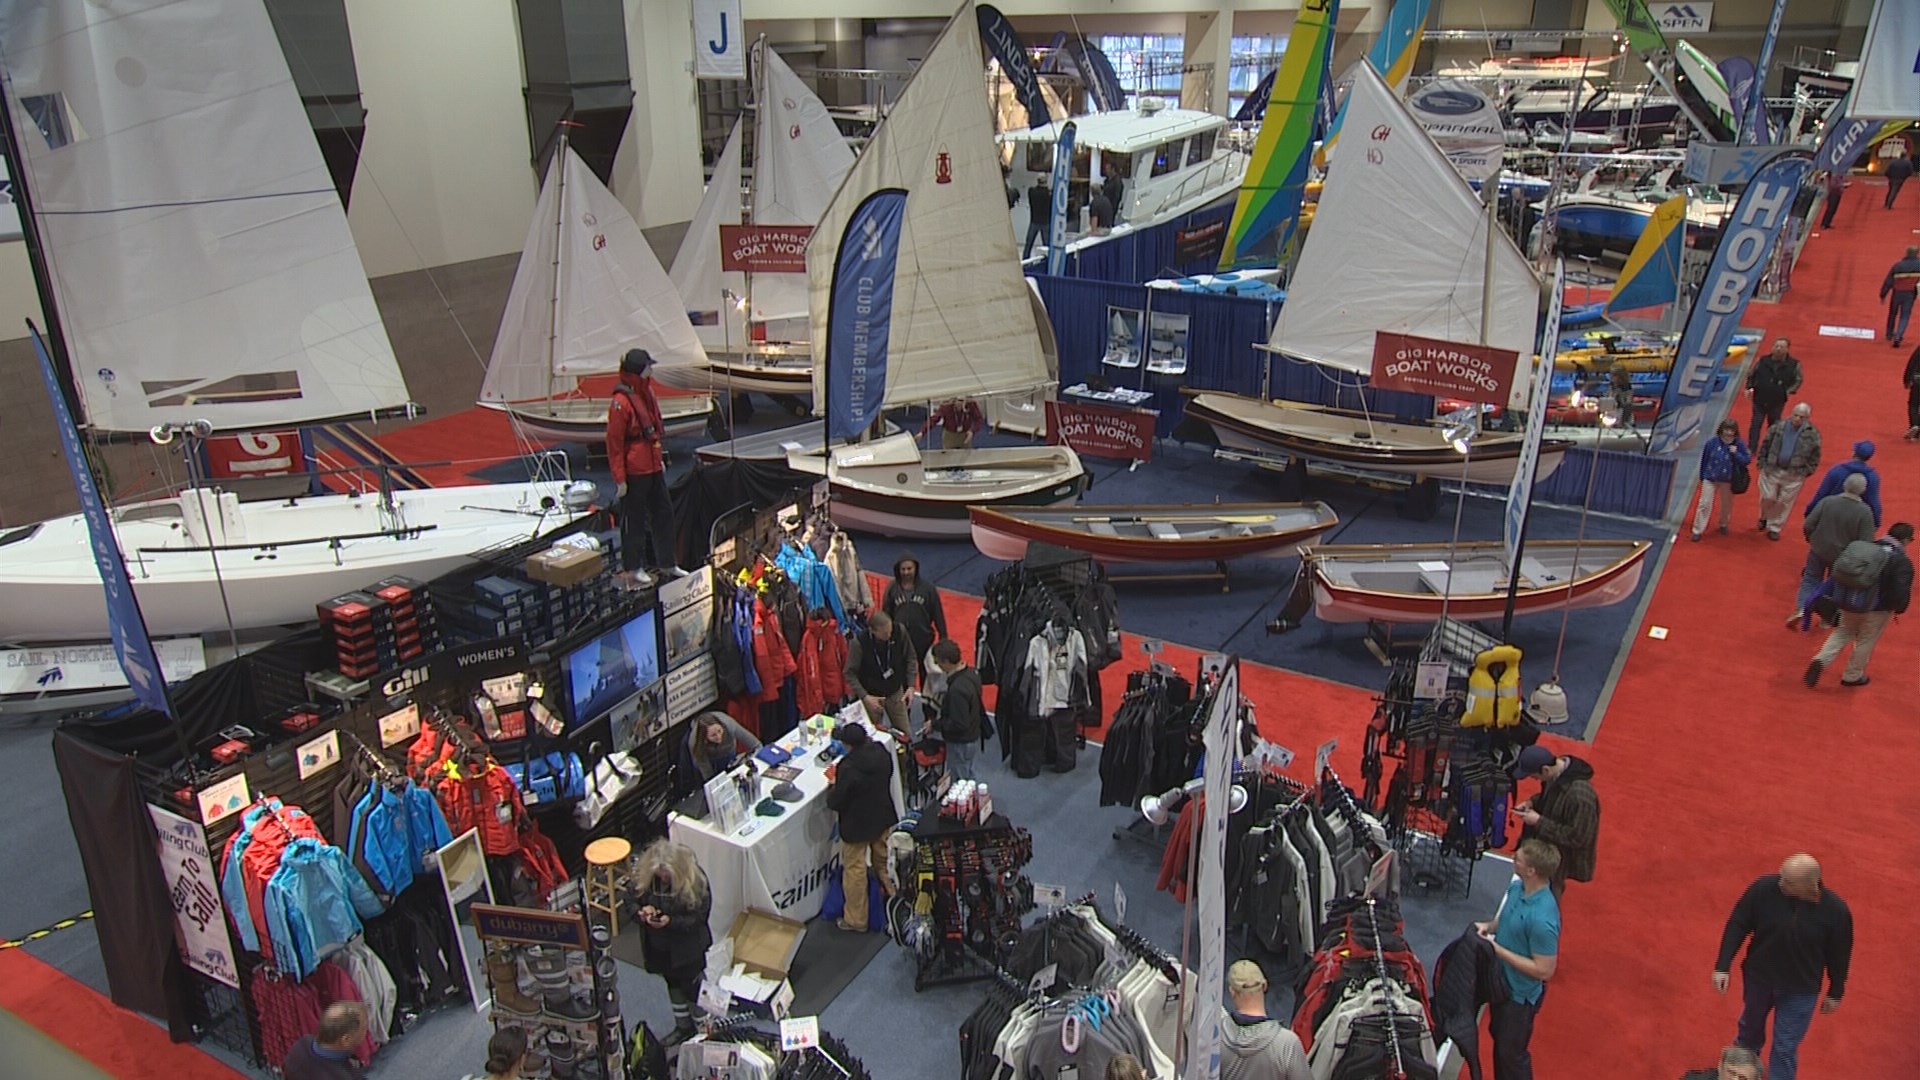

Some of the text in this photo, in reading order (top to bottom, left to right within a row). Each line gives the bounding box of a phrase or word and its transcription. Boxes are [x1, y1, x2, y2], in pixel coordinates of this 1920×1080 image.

[709, 12, 727, 55] J
[763, 233, 808, 245] HARBO
[732, 243, 806, 262] BOAT WOR
[1677, 182, 1790, 398] HOBIE
[850, 276, 874, 423] CLUB MEMBERSHIP!
[1396, 348, 1492, 373] GIG HARBOR
[1385, 360, 1499, 392] BOAT WORKS
[1085, 413, 1137, 432] HARBOR
[1094, 424, 1144, 449] WORKS
[8, 650, 48, 668] SAIL
[457, 647, 515, 667] WOMEN'S
[382, 665, 429, 696] Gill
[184, 838, 208, 859] Club
[181, 856, 201, 880] To
[185, 881, 219, 932] Sail!
[489, 916, 558, 937] dubarry
[214, 964, 239, 985] Club
